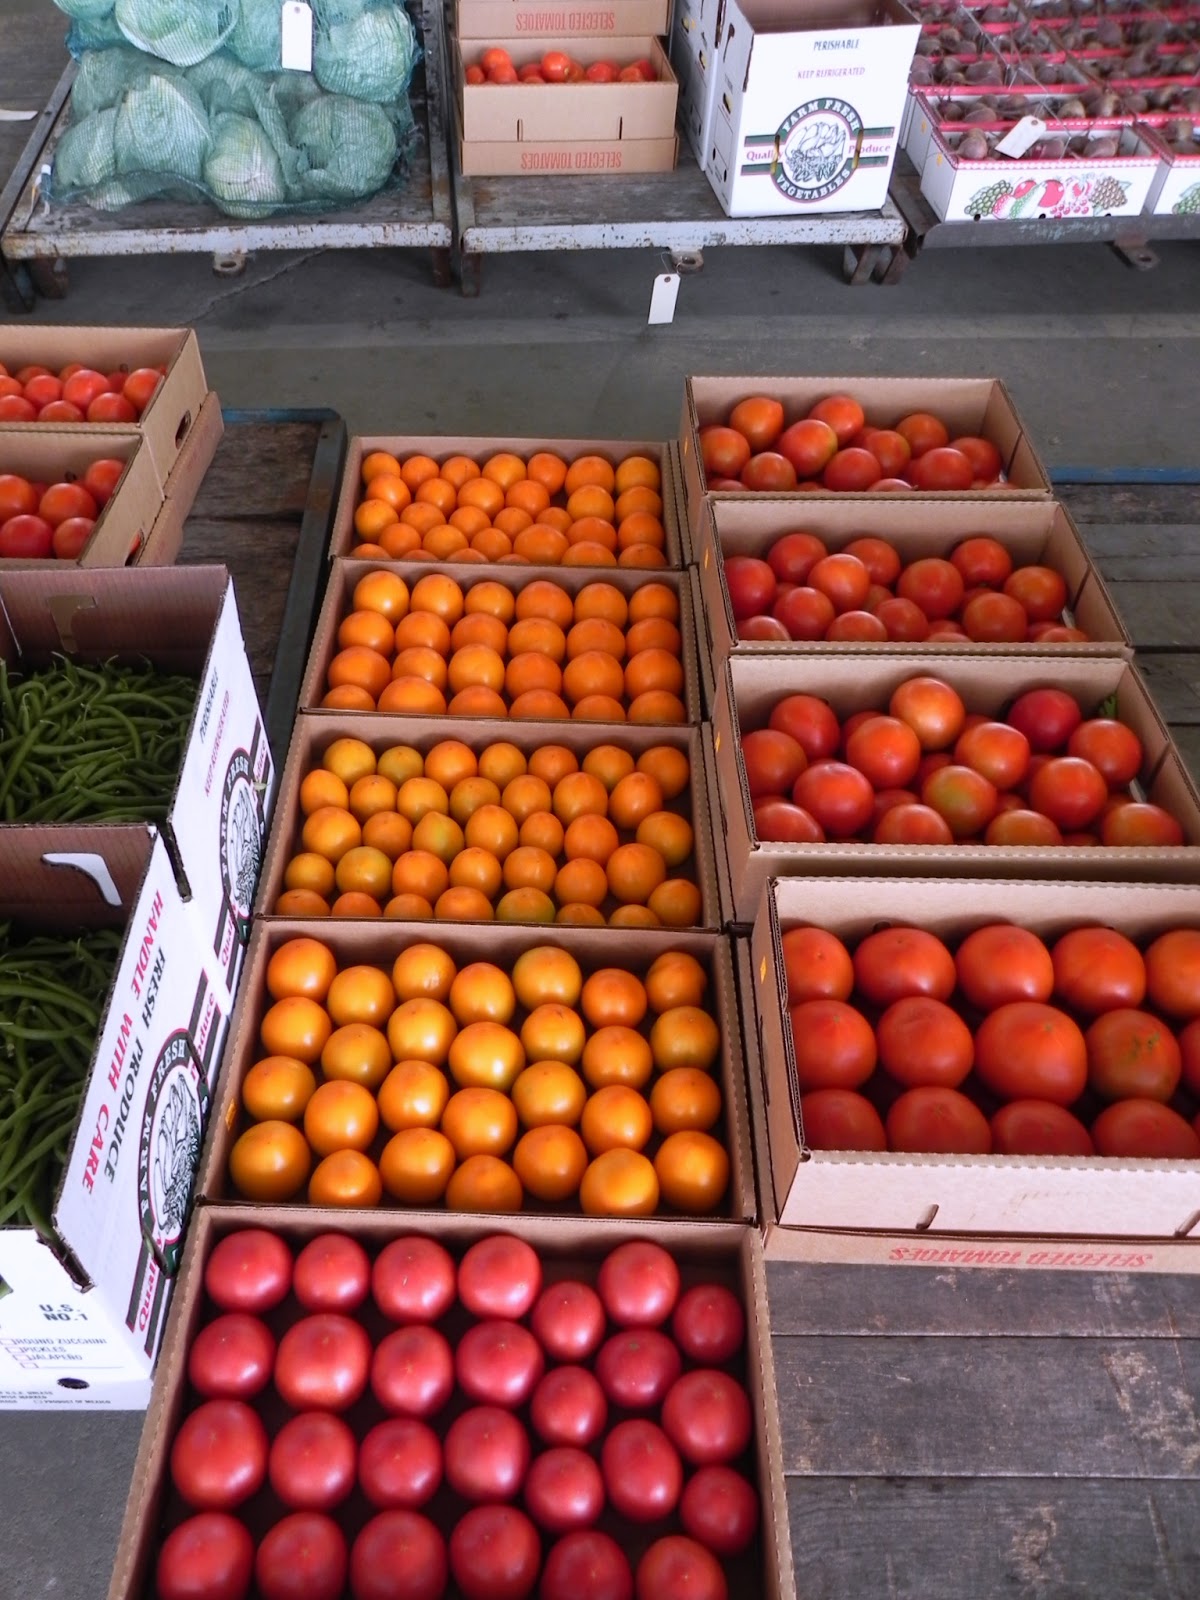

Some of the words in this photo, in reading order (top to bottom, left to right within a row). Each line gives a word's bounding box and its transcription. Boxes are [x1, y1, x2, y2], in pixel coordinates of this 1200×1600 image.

[515, 12, 567, 31] TOMATOES
[569, 11, 616, 30] SELECTED
[813, 39, 860, 51] PERISHABLE
[797, 69, 814, 79] KEEP
[815, 66, 866, 78] REFRIGERATED
[781, 100, 819, 131] FARM
[824, 99, 860, 131] FRESH
[848, 144, 891, 155] Poduce
[520, 152, 573, 170] TOMATOES
[575, 151, 623, 169] SELECTED
[775, 169, 851, 200] VEGETABLES
[130, 889, 163, 1000] HANDLE
[141, 947, 166, 1029] FRESH
[108, 1013, 133, 1092] WITH
[104, 1036, 144, 1185] PRODUCE
[82, 1103, 109, 1194] CARE
[888, 1247, 1021, 1265] TOMATOES
[1025, 1253, 1153, 1268] SELECTED
[39, 1304, 81, 1312] U.S.
[43, 1313, 88, 1321] NO.1
